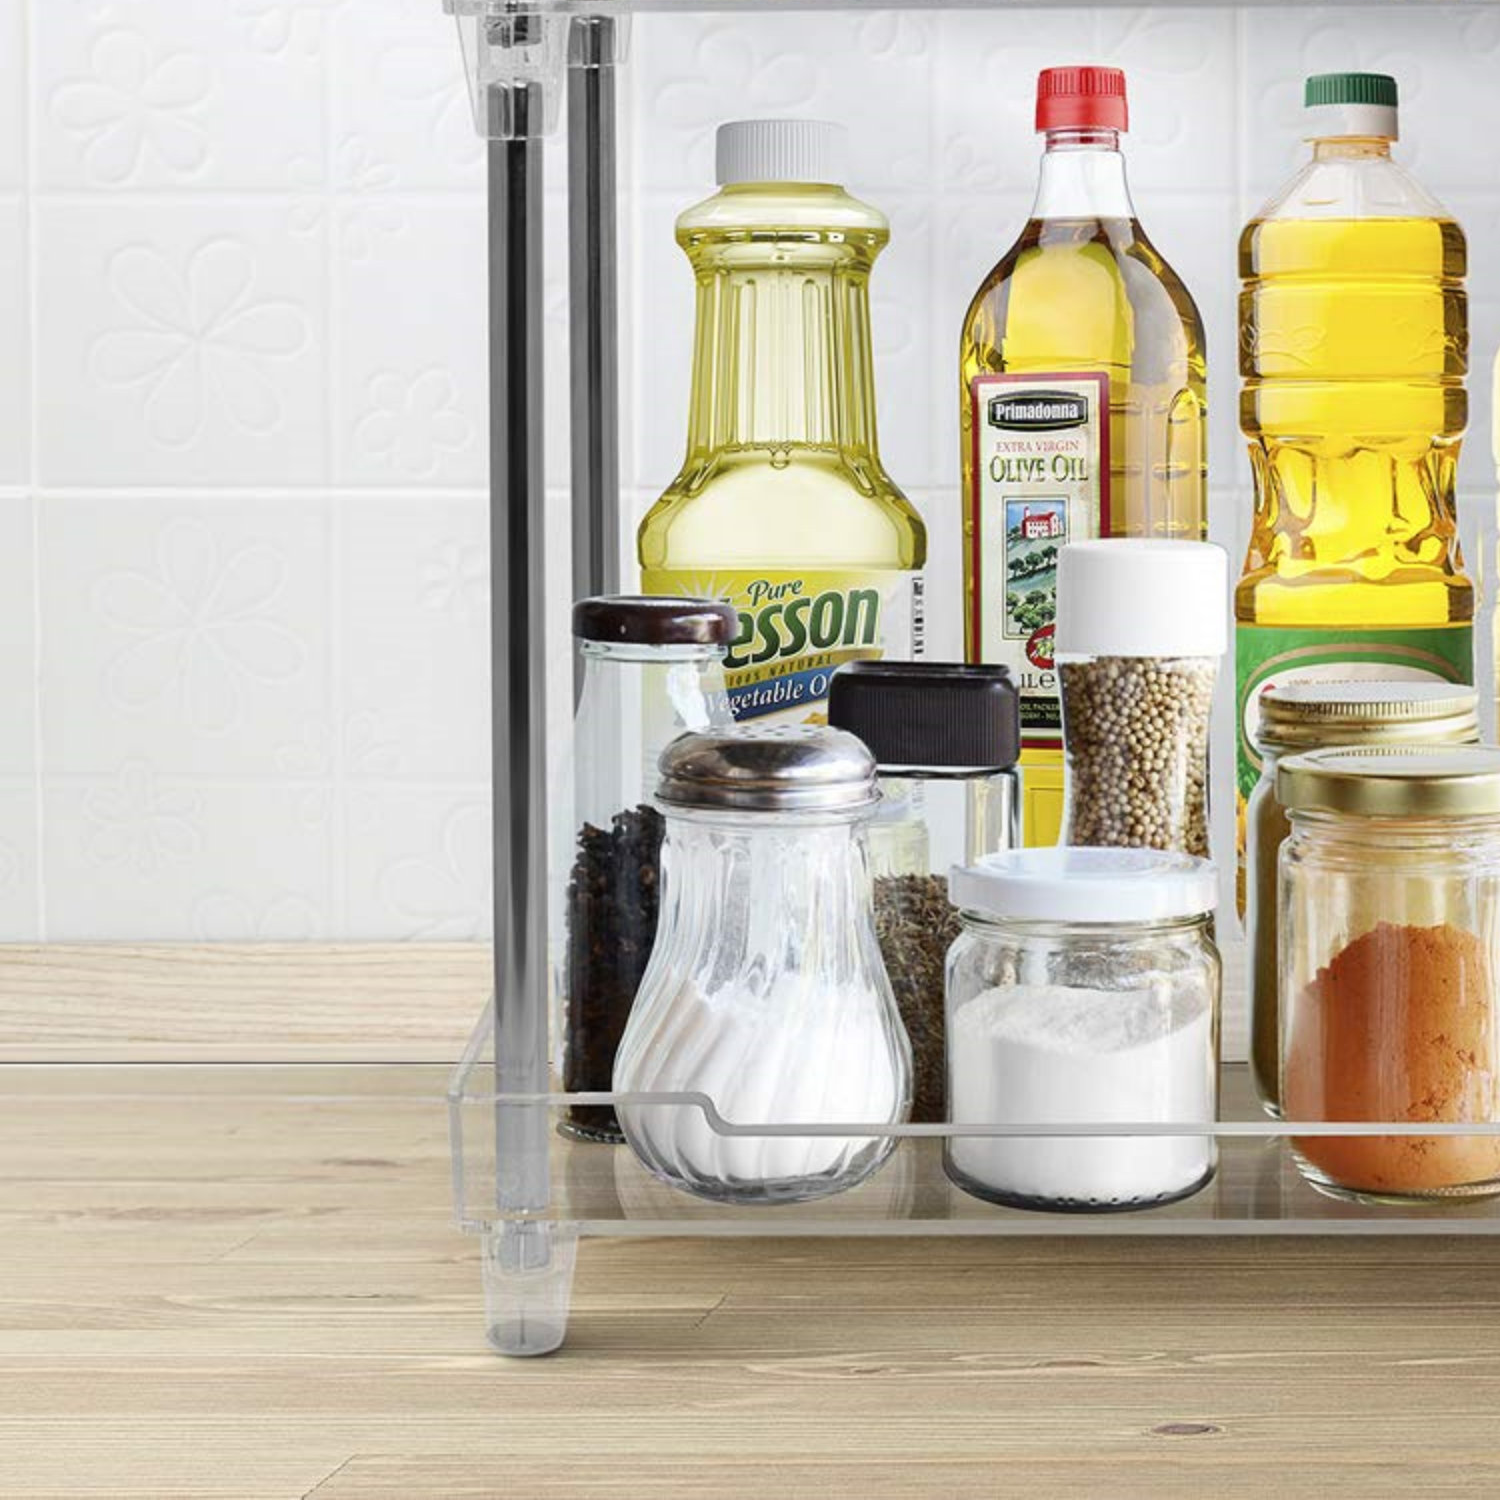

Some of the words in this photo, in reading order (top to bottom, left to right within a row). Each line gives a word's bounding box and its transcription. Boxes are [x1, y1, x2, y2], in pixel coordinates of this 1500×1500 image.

[994, 401, 1079, 421] Primadonna
[996, 441, 1033, 453] EXTRA
[1035, 439, 1080, 452] VIRGIN
[989, 455, 1046, 483] OLIVE
[1051, 453, 1089, 482] OIL
[747, 578, 804, 607] Pure
[722, 588, 880, 669] esson
[768, 653, 833, 677] NATURAL
